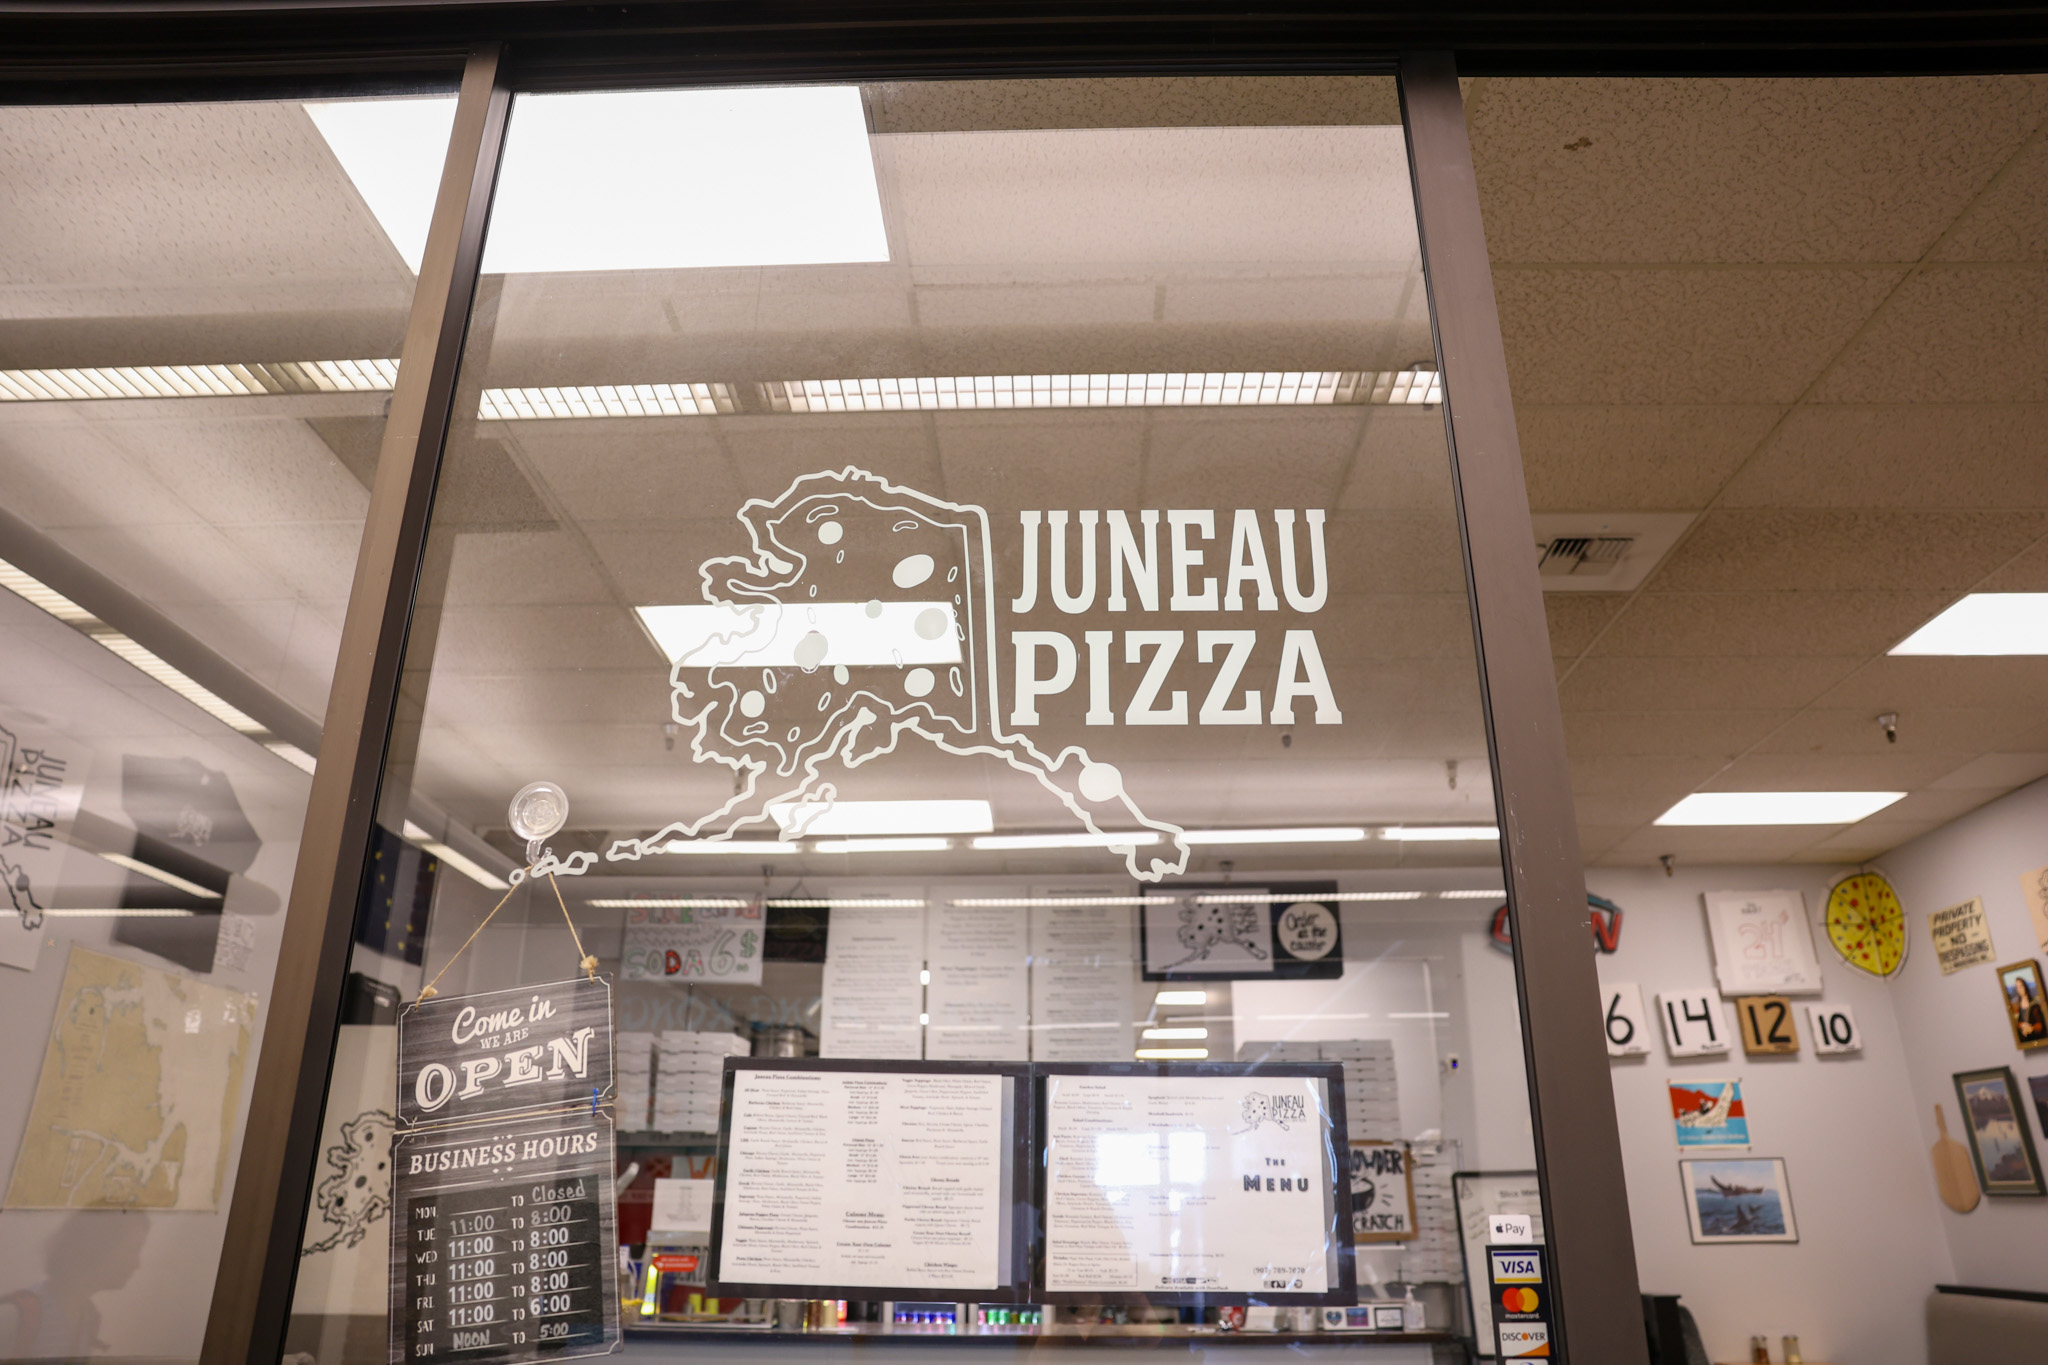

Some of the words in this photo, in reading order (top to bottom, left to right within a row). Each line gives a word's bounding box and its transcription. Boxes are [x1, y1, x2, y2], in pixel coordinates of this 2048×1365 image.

[1011, 508, 1329, 614] JUNEAU
[1010, 629, 1343, 726] PIZZA
[1932, 913, 1982, 937] PROPERTY
[1933, 900, 1975, 925] PRIVATE
[625, 949, 704, 978] SODA
[451, 1006, 524, 1045] Come
[528, 995, 557, 1023] in
[1667, 998, 1716, 1046] 14
[1748, 1001, 1791, 1046] 12
[1819, 1013, 1852, 1045] 10
[480, 1035, 500, 1049] WE
[503, 1027, 529, 1046] ARE
[415, 1026, 595, 1113] OPEN
[1272, 1095, 1304, 1108] JUNEAU
[1272, 1108, 1306, 1118] PIZZA
[409, 1142, 516, 1175] BUSINESS
[522, 1132, 598, 1161] HOURS
[1350, 1148, 1403, 1176] OWDER
[511, 1195, 524, 1207] TO
[532, 1179, 586, 1203] Closed
[1243, 1174, 1309, 1192] MENU
[450, 1215, 495, 1235] 11:00
[511, 1217, 524, 1229] TO
[531, 1205, 571, 1226] 8:00
[1353, 1213, 1405, 1232] CRATCH
[1505, 1223, 1525, 1236] Pay
[449, 1236, 494, 1258] 11:00
[512, 1240, 524, 1252] TO
[530, 1227, 569, 1248] 8:00
[449, 1259, 495, 1281] 11:00
[512, 1262, 524, 1275] TO
[529, 1250, 568, 1270] 8:00
[1499, 1261, 1535, 1273] VISA
[449, 1281, 494, 1304] 11:00
[512, 1285, 525, 1298] TO
[530, 1271, 569, 1293] 8:00
[449, 1304, 494, 1326] 11:00
[512, 1308, 525, 1321] TO
[529, 1294, 571, 1316] 6:00
[453, 1329, 490, 1350] NOON
[512, 1331, 525, 1344] TO
[539, 1322, 569, 1339] 5:00
[1502, 1332, 1546, 1341] DISCOVER
